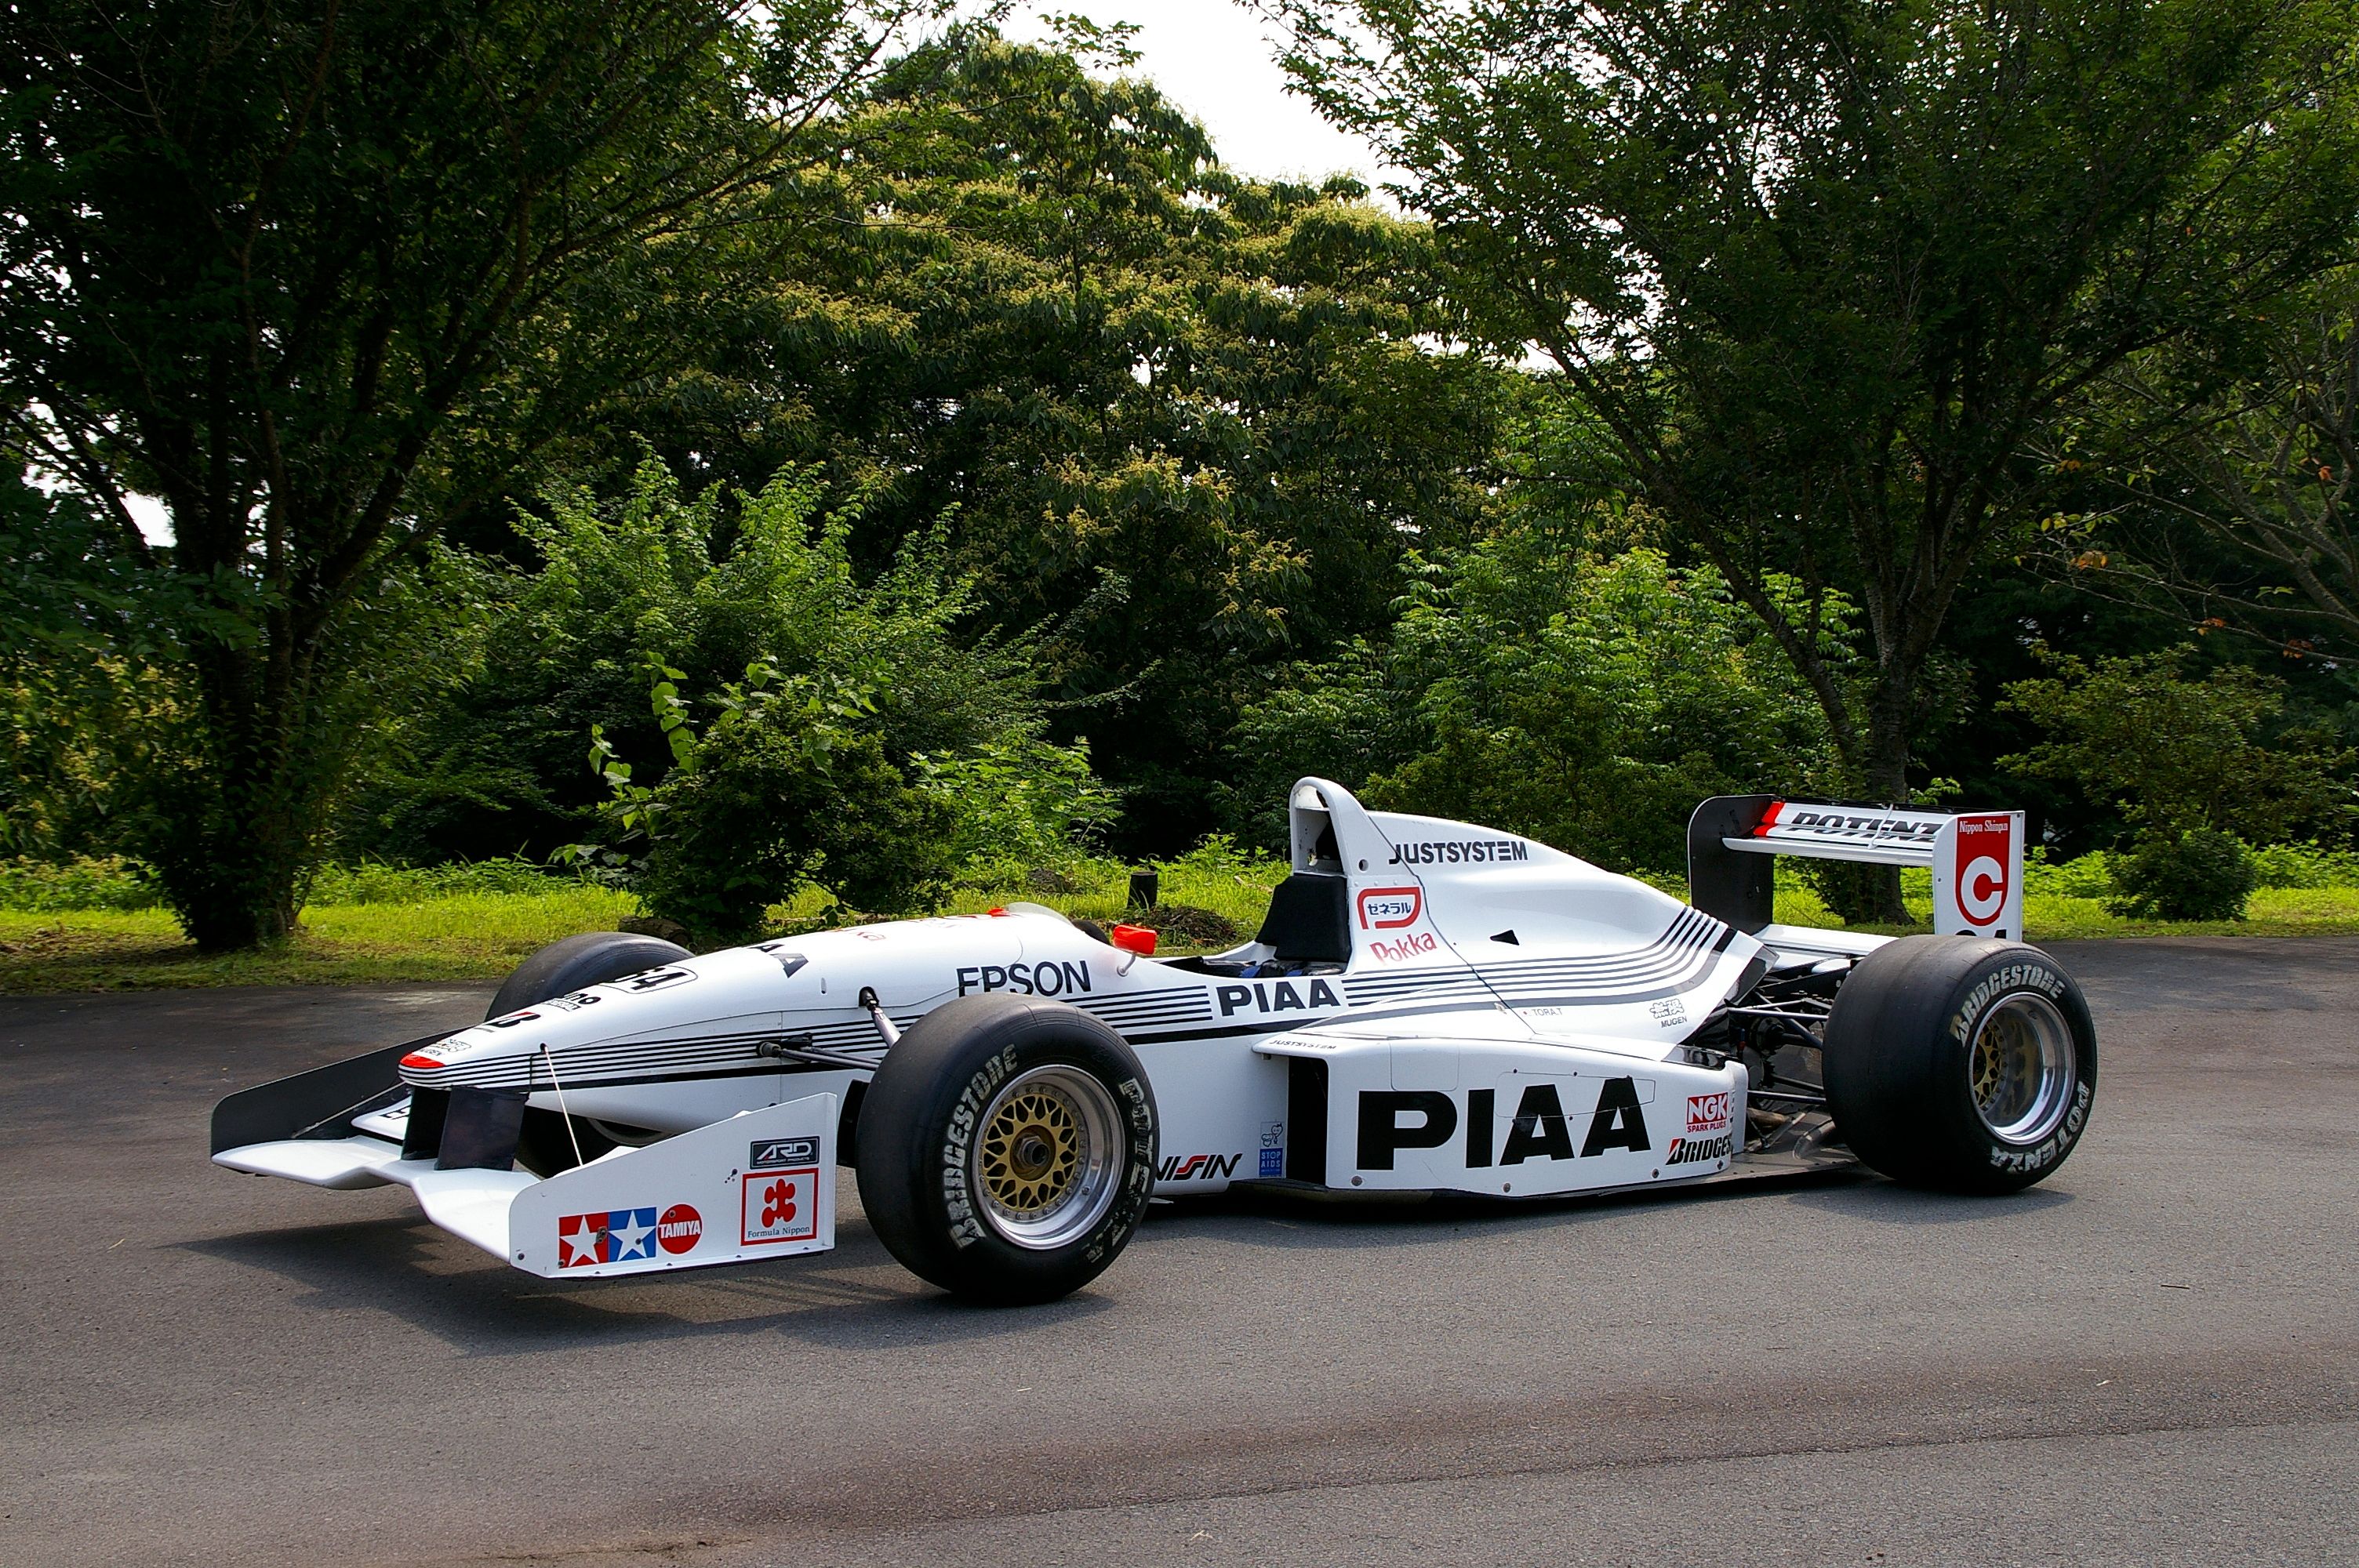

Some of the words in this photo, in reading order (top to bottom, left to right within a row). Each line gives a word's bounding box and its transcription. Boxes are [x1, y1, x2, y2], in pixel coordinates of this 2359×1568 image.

[1785, 812, 1944, 843] POTENZ
[1959, 820, 1983, 834] Nippon
[1389, 841, 1528, 865] JUSTSYSTEM
[1367, 902, 1412, 916] ゼネラル
[1369, 932, 1438, 967] Pokka
[956, 960, 1092, 997] EPSON
[1216, 978, 1341, 1017] PIAA
[1949, 964, 2066, 1048] BRIDGESTONE
[1660, 1015, 1688, 1028] MUGEN
[1269, 1040, 1337, 1050] JUSTSYSTEM
[1688, 1093, 1728, 1123] NGK
[1357, 1076, 1652, 1171] PIAA
[1687, 1123, 1709, 1133] SPARK
[1710, 1120, 1726, 1131] PLUGS
[756, 1142, 812, 1160] ARD
[1261, 1151, 1281, 1160] STOP
[1260, 1160, 1281, 1168] AIDS
[659, 1219, 701, 1240] TAMIYA
[747, 1228, 780, 1238] Formula
[782, 1225, 810, 1236] Nippon
